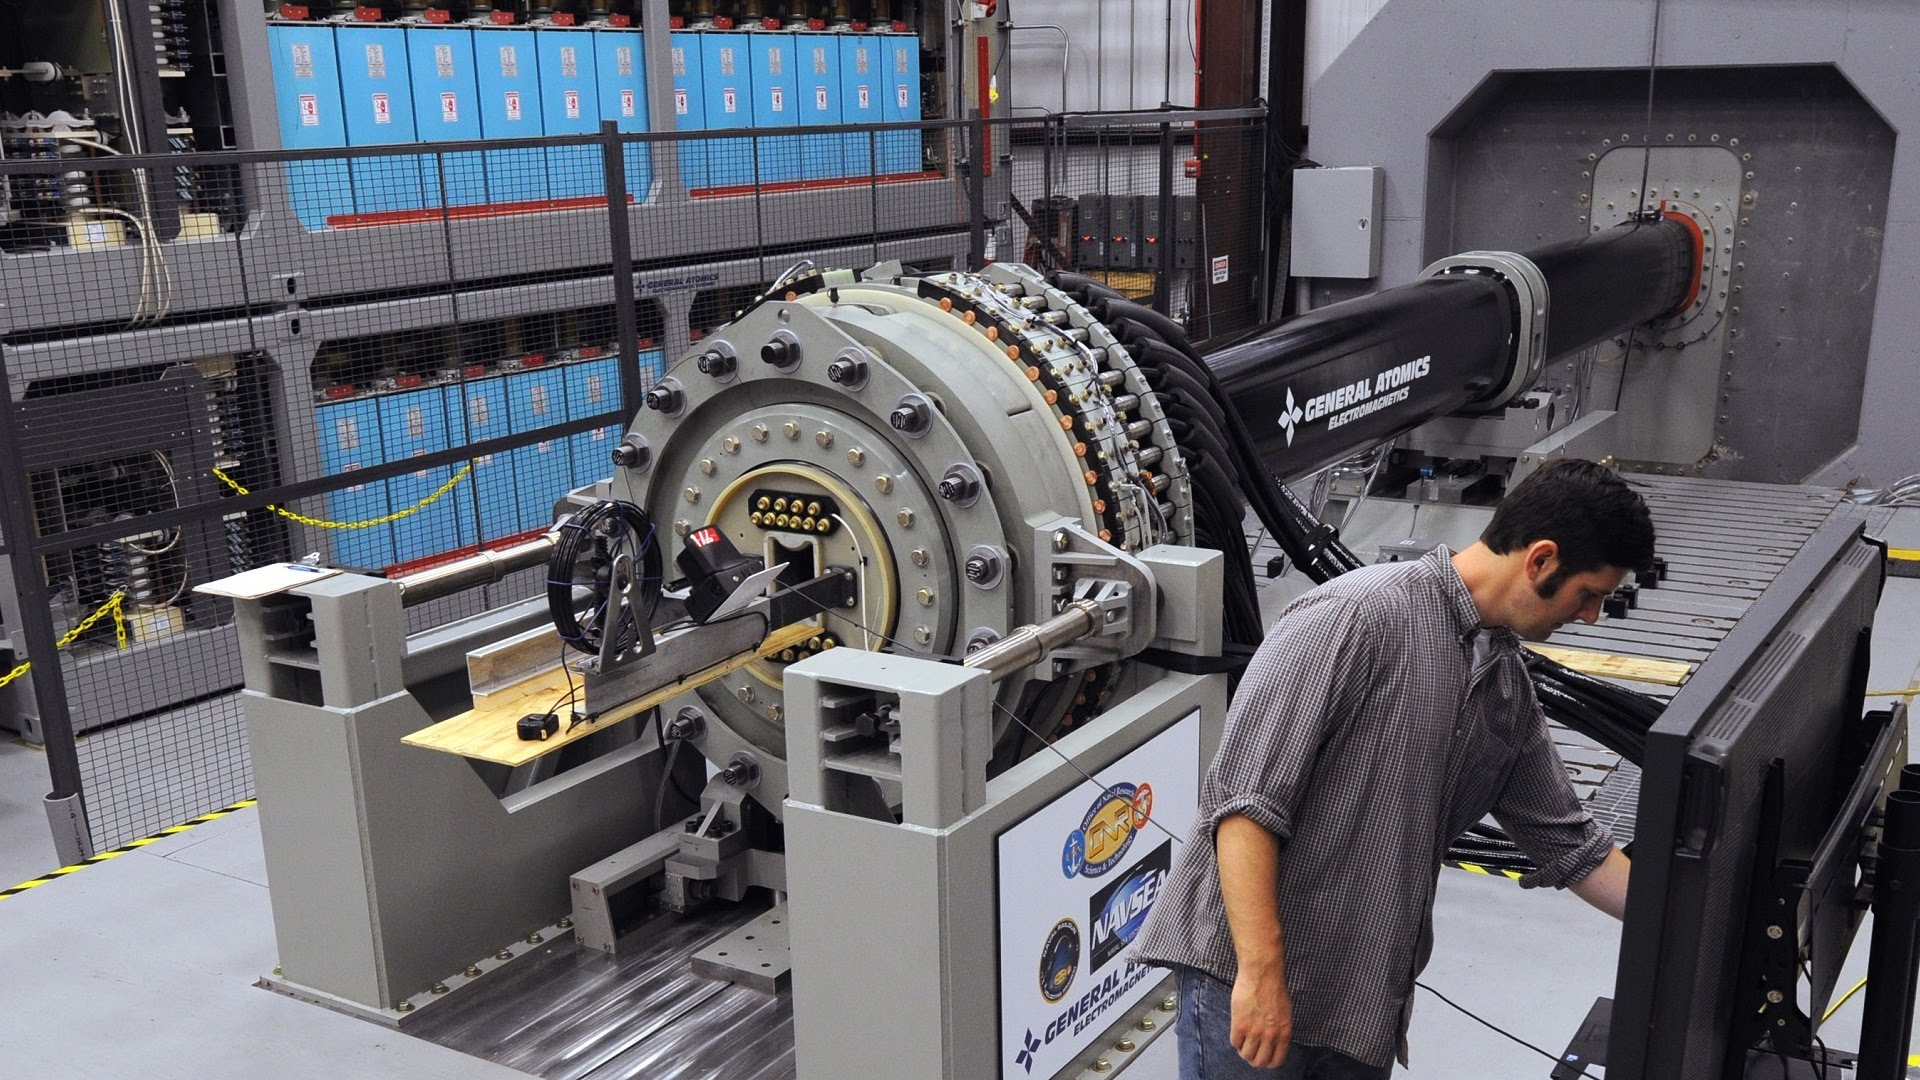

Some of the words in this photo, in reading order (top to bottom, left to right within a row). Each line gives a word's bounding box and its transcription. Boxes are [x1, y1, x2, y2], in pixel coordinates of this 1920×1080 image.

[1304, 378, 1372, 422] GENERAL
[1374, 355, 1431, 395] ATOMICS
[1328, 386, 1410, 431] ELECTROMAGNETICS
[1082, 807, 1097, 831] Office
[1084, 866, 1102, 875] Science
[1092, 868, 1166, 951] NAVSEA
[1044, 969, 1120, 1045] GENERAL
